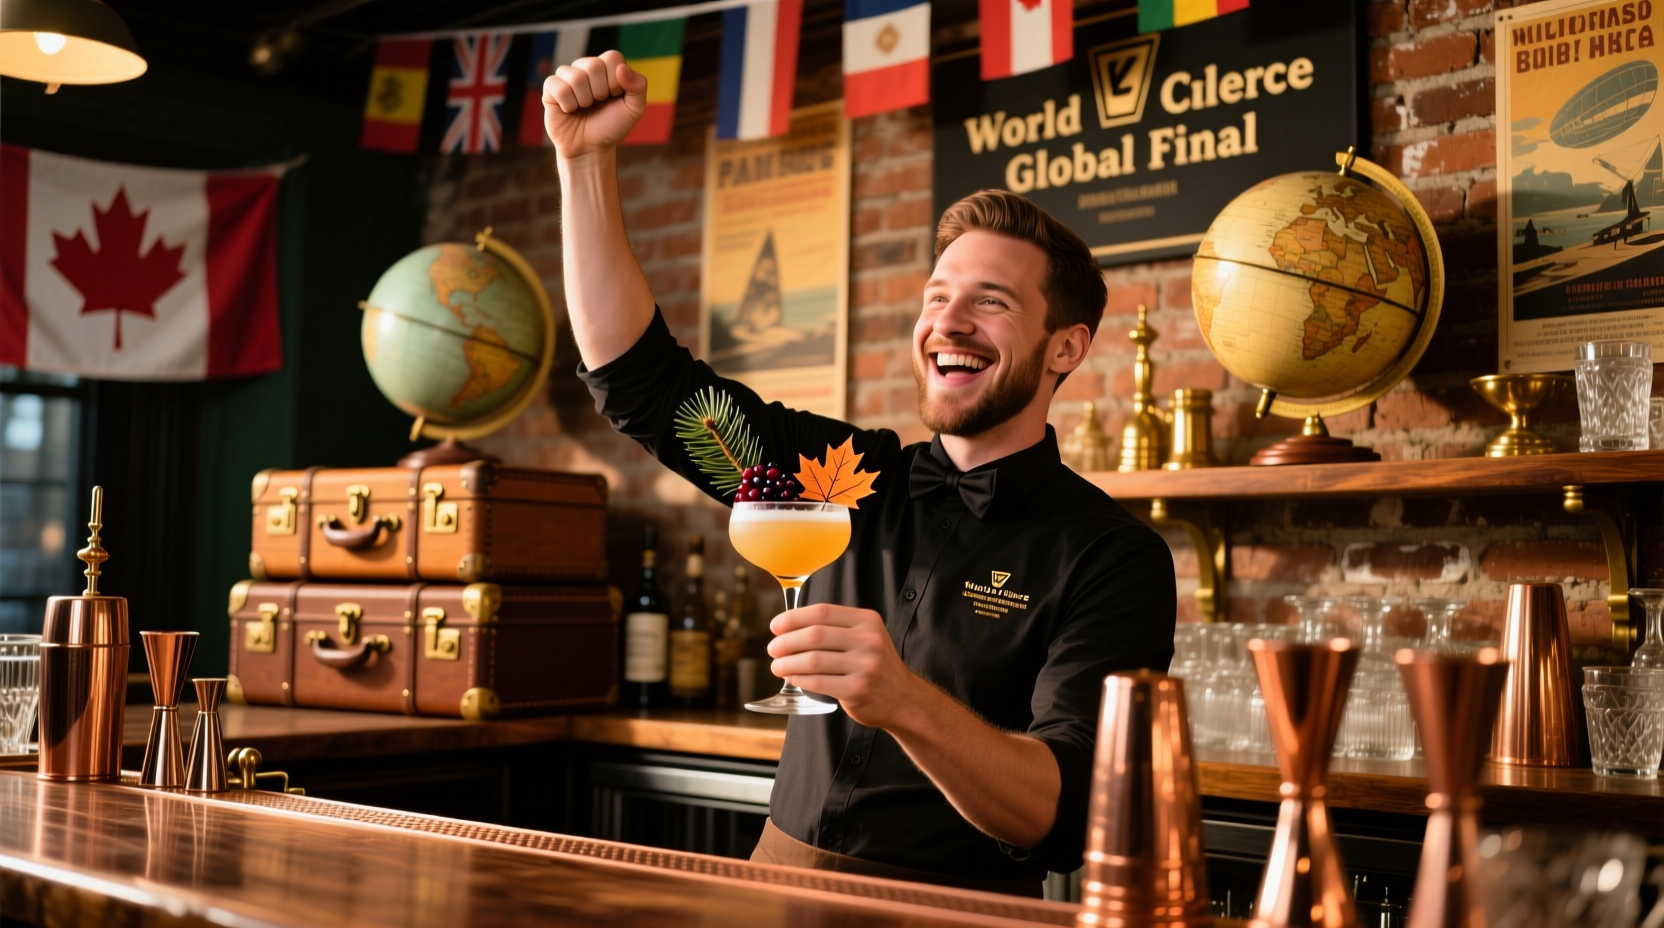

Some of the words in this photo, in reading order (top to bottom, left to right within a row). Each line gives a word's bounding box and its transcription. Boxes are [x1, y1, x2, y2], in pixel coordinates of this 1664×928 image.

[964, 94, 1083, 154] World
[1005, 133, 1136, 194] Global
[1148, 111, 1259, 170] Final
